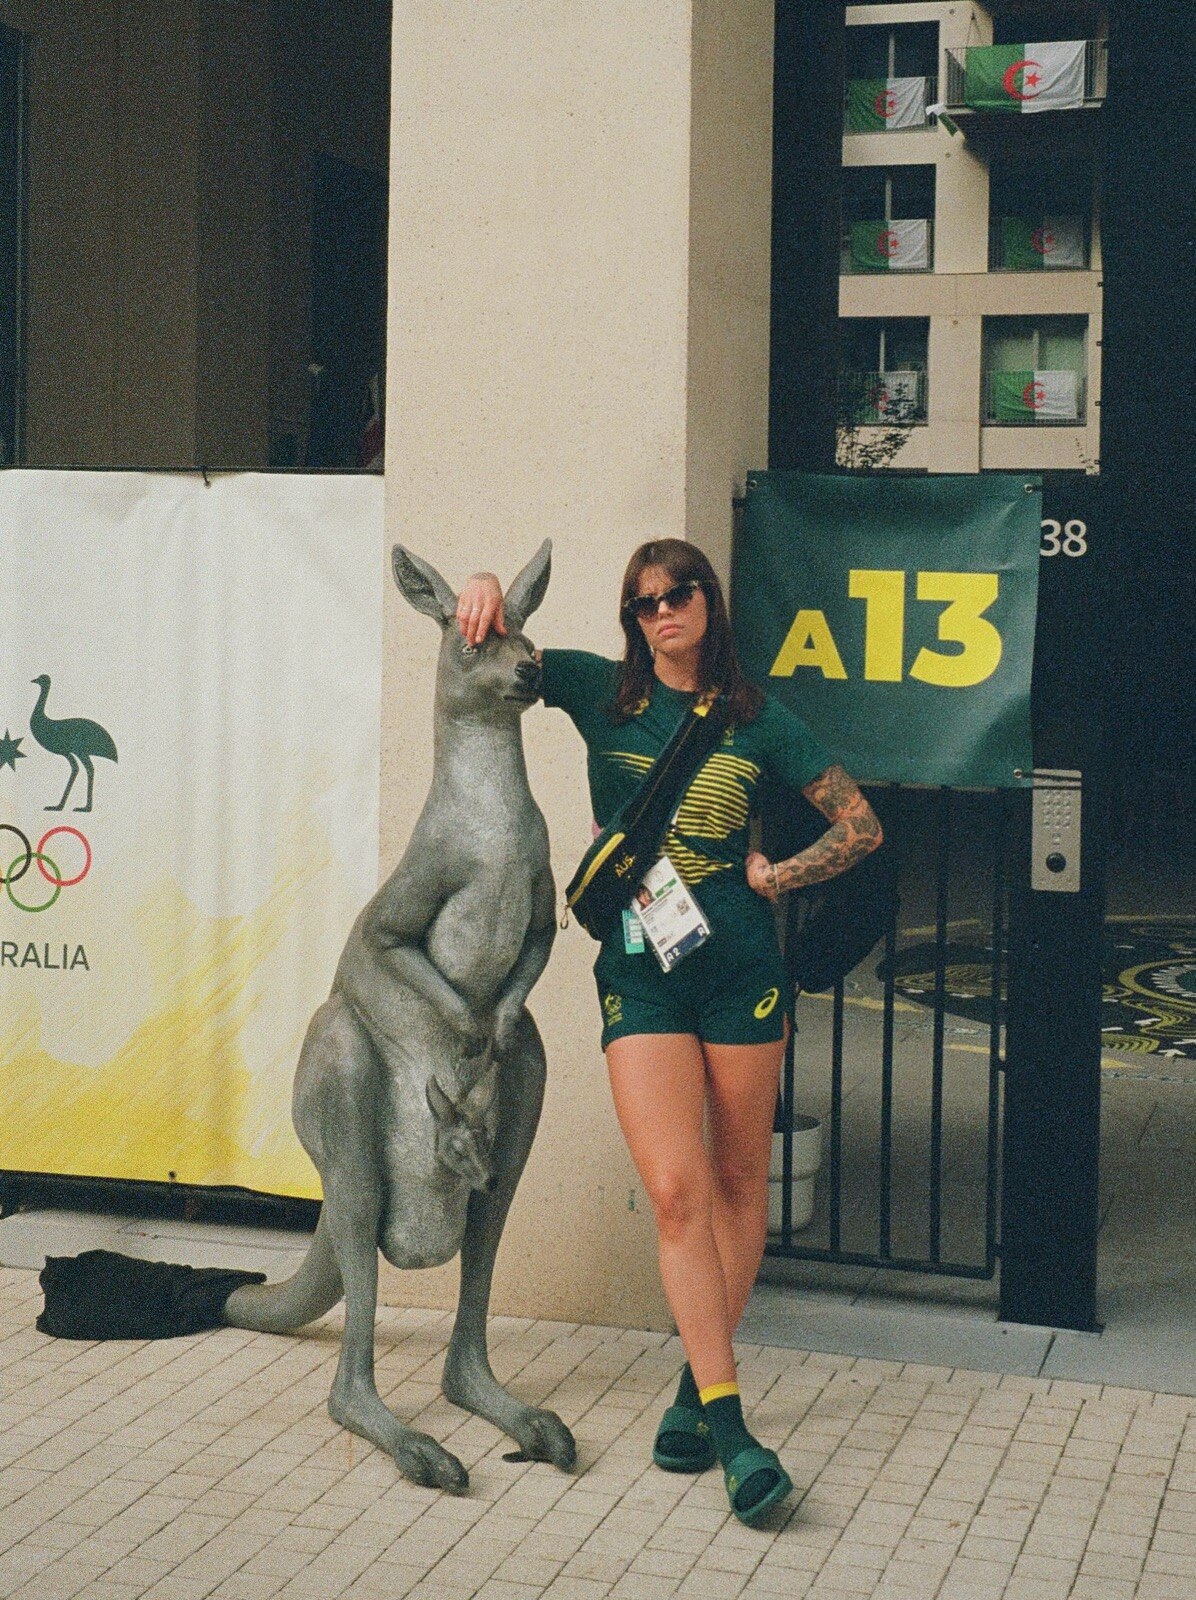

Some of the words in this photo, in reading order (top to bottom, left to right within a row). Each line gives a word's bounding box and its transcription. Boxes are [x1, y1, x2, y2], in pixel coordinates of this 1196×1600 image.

[1040, 519, 1088, 557] 38
[768, 568, 1003, 688] A13
[1, 941, 90, 971] RALIA
